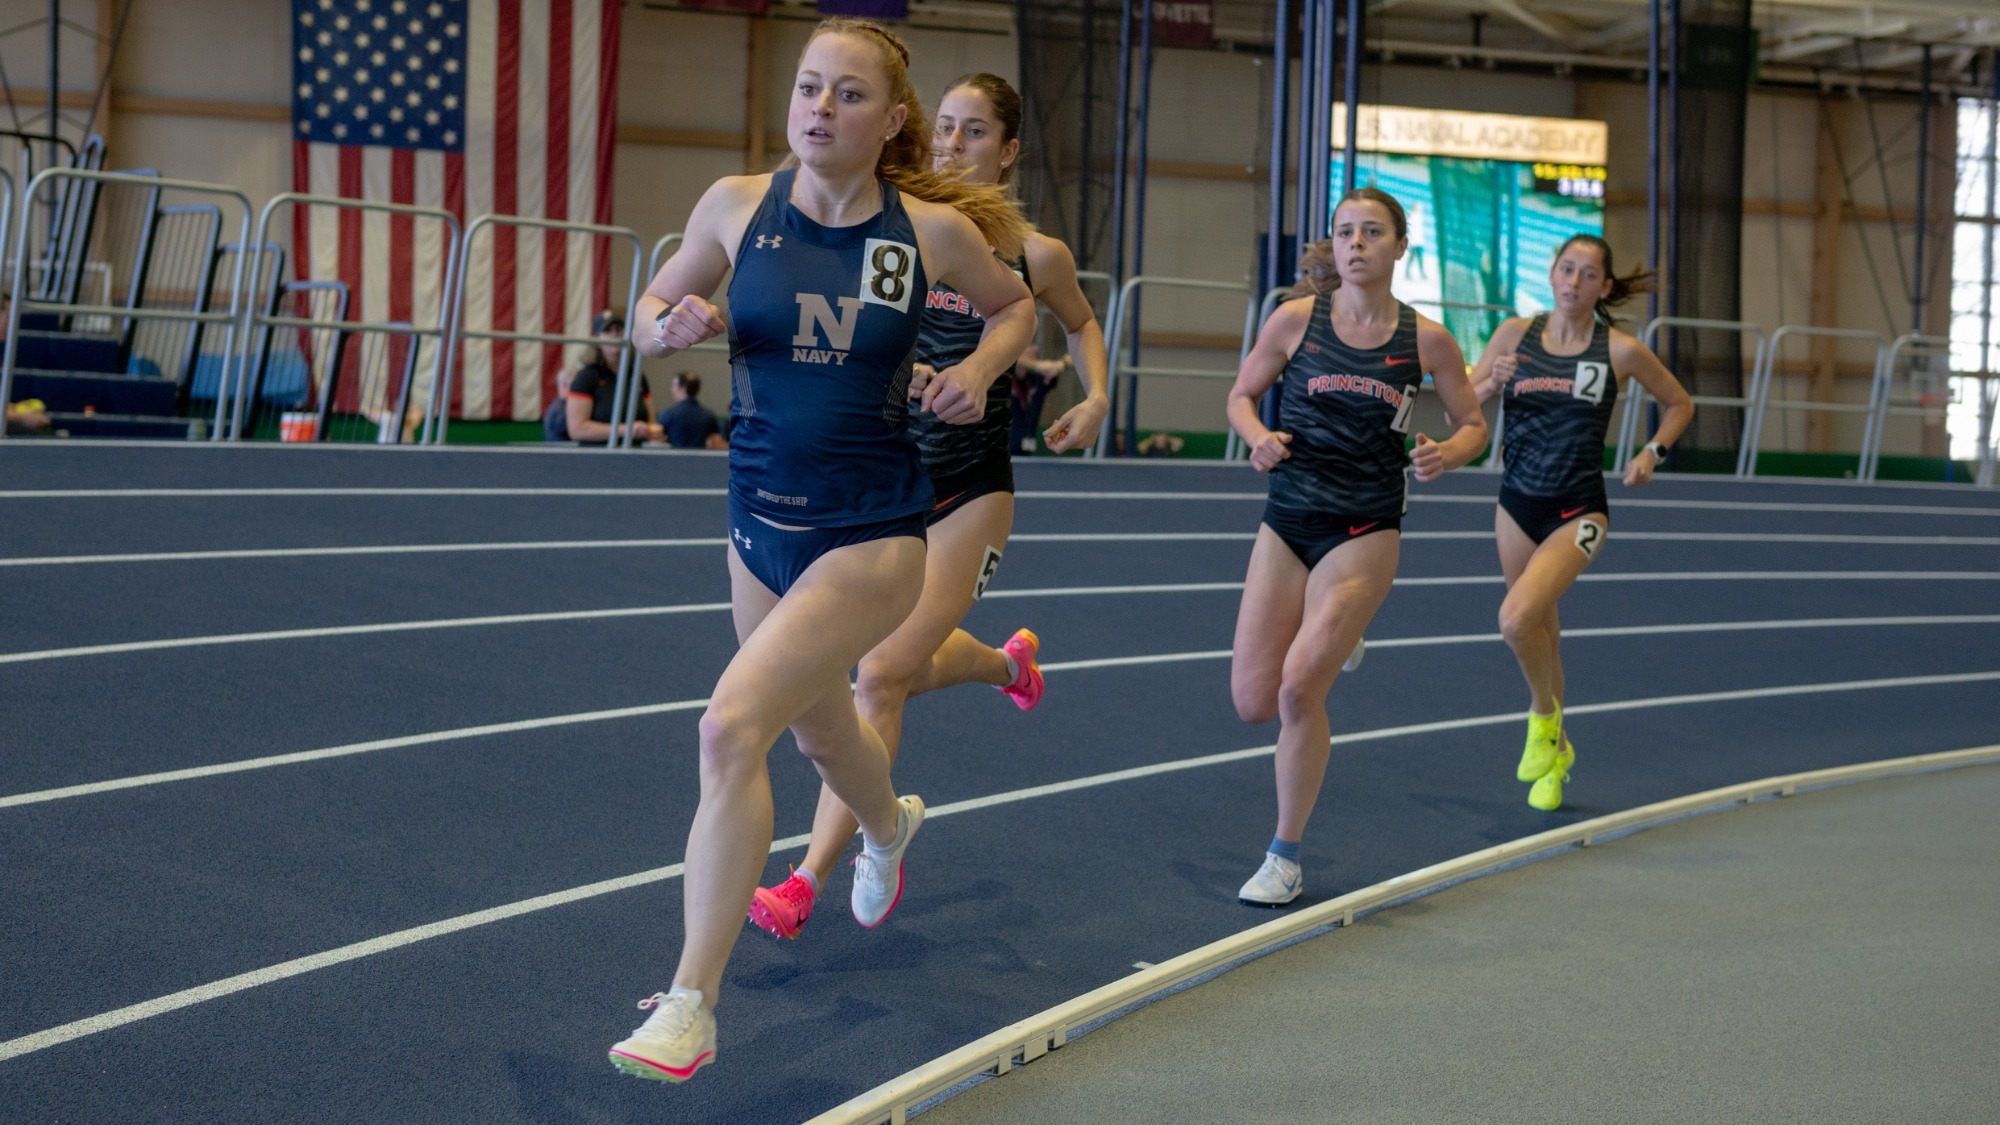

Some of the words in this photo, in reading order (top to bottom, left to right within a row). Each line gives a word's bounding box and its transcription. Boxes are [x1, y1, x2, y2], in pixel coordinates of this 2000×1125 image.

[1394, 117, 1471, 148] NAVAL
[1474, 121, 1601, 155] ACADEMY
[871, 244, 909, 303] 8
[792, 292, 865, 350] N
[792, 348, 849, 366] NAVY
[1580, 365, 1599, 398] 2
[1580, 522, 1599, 554] 2
[977, 550, 1001, 598] 5
